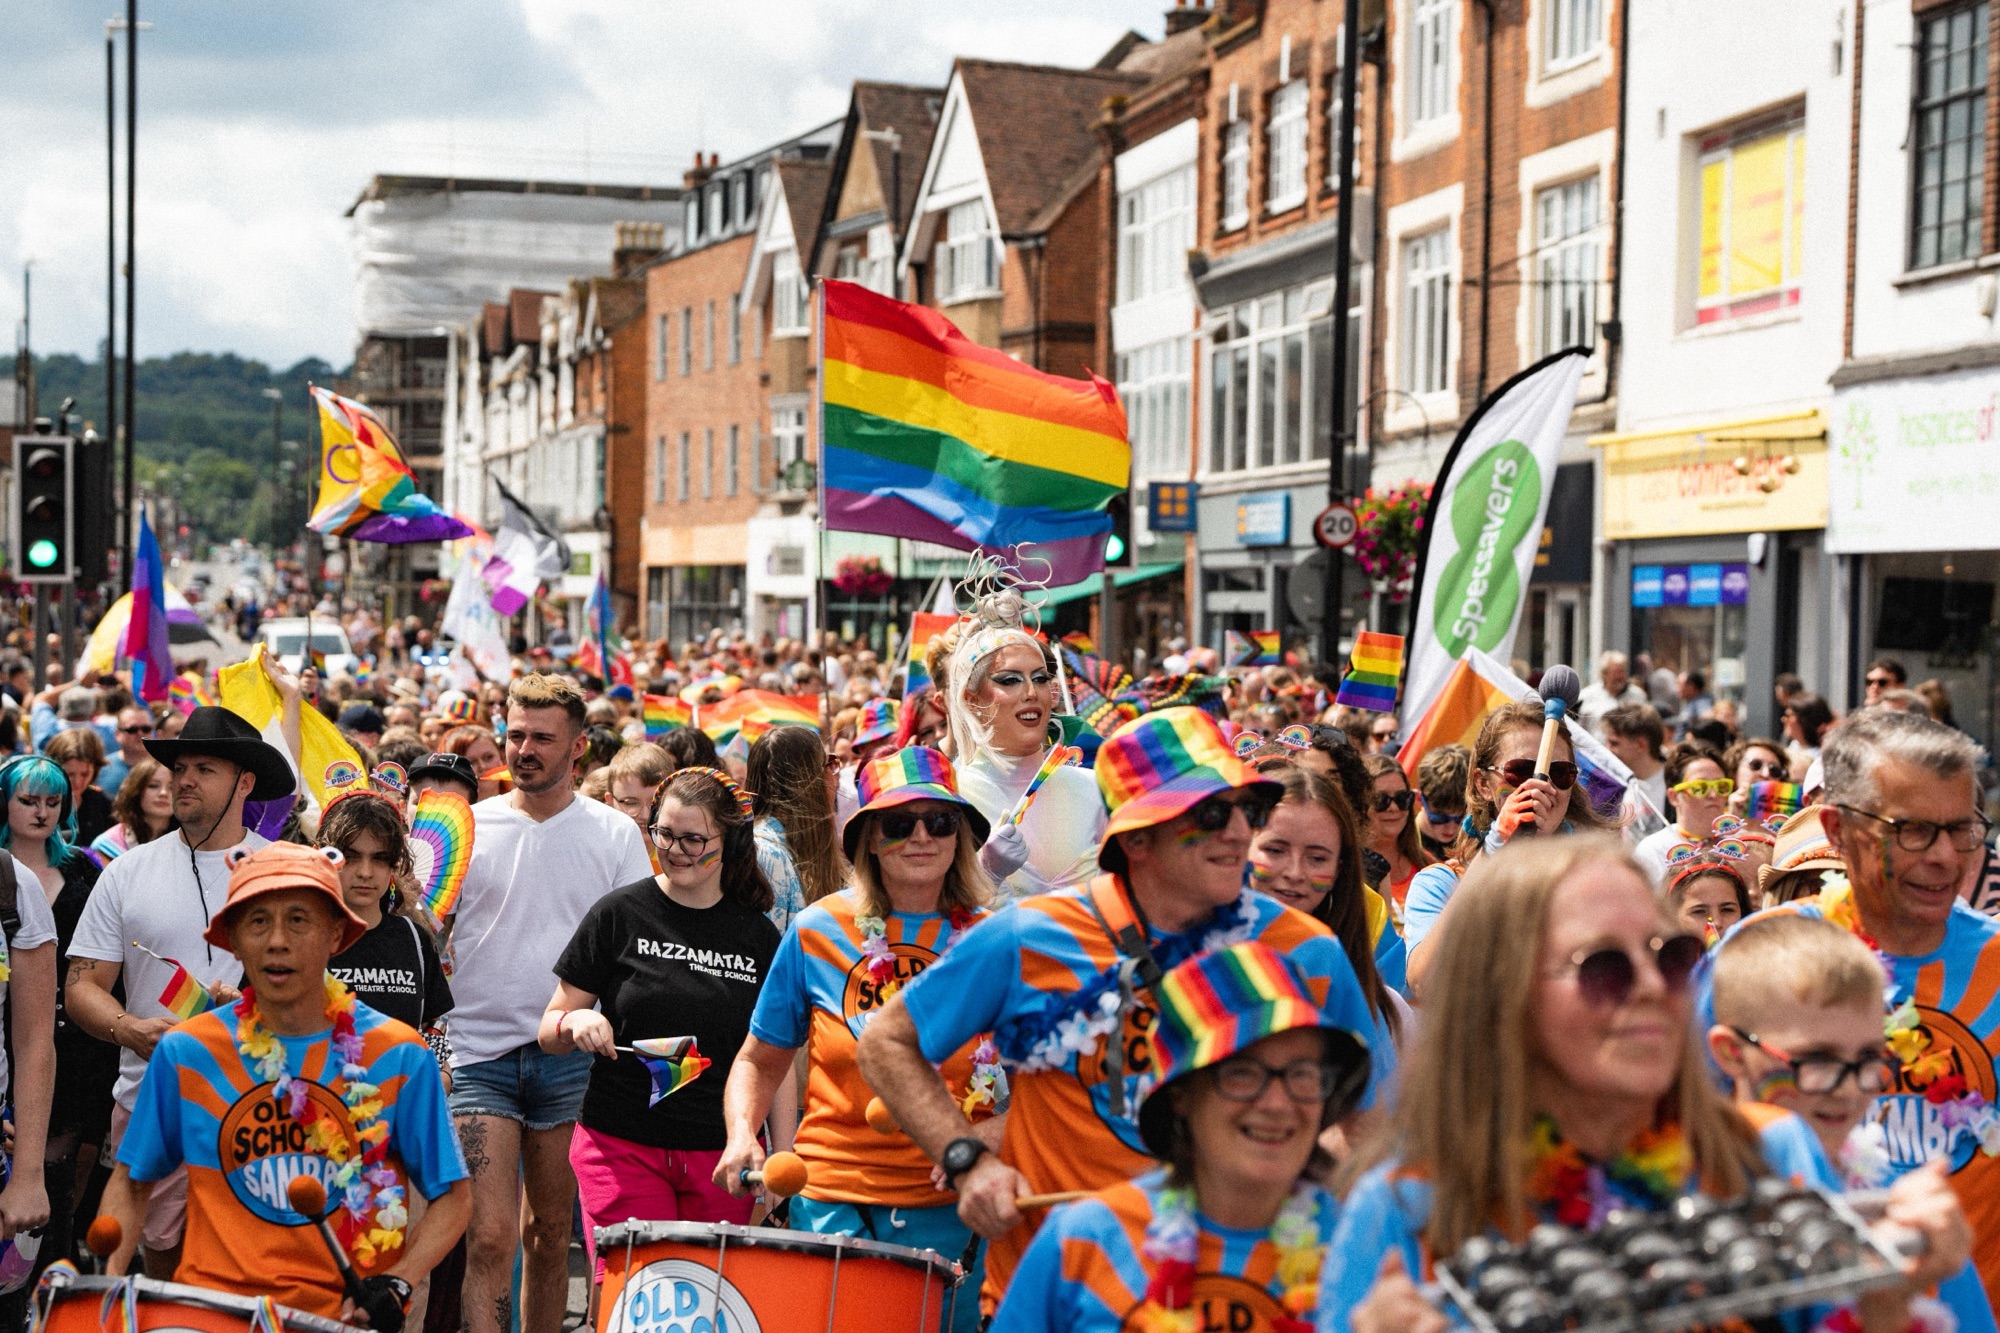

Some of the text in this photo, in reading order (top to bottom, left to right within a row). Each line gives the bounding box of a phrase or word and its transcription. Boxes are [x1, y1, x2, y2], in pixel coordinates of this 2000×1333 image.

[1323, 515, 1353, 535] 20
[1452, 457, 1518, 642] Specsavers
[1238, 742, 1261, 756] PRIDE
[1284, 736, 1306, 748] PRIDE
[331, 773, 357, 785] PRIDE
[378, 773, 402, 789] PRIDE
[1720, 822, 1740, 834] PRIDE
[1672, 851, 1696, 863] PRIDE
[1719, 848, 1743, 859] PRIDE
[637, 938, 757, 973] RAZZAMATAZ
[331, 967, 416, 986] ZZAMATAZ
[689, 963, 757, 984] THEATRE SCHOOLS
[354, 984, 417, 994] THEATRE SCHOOLS
[253, 1098, 295, 1123] OL
[233, 1124, 309, 1164] SCHO
[629, 1281, 699, 1327] OLD
[1202, 1301, 1254, 1332] LD
